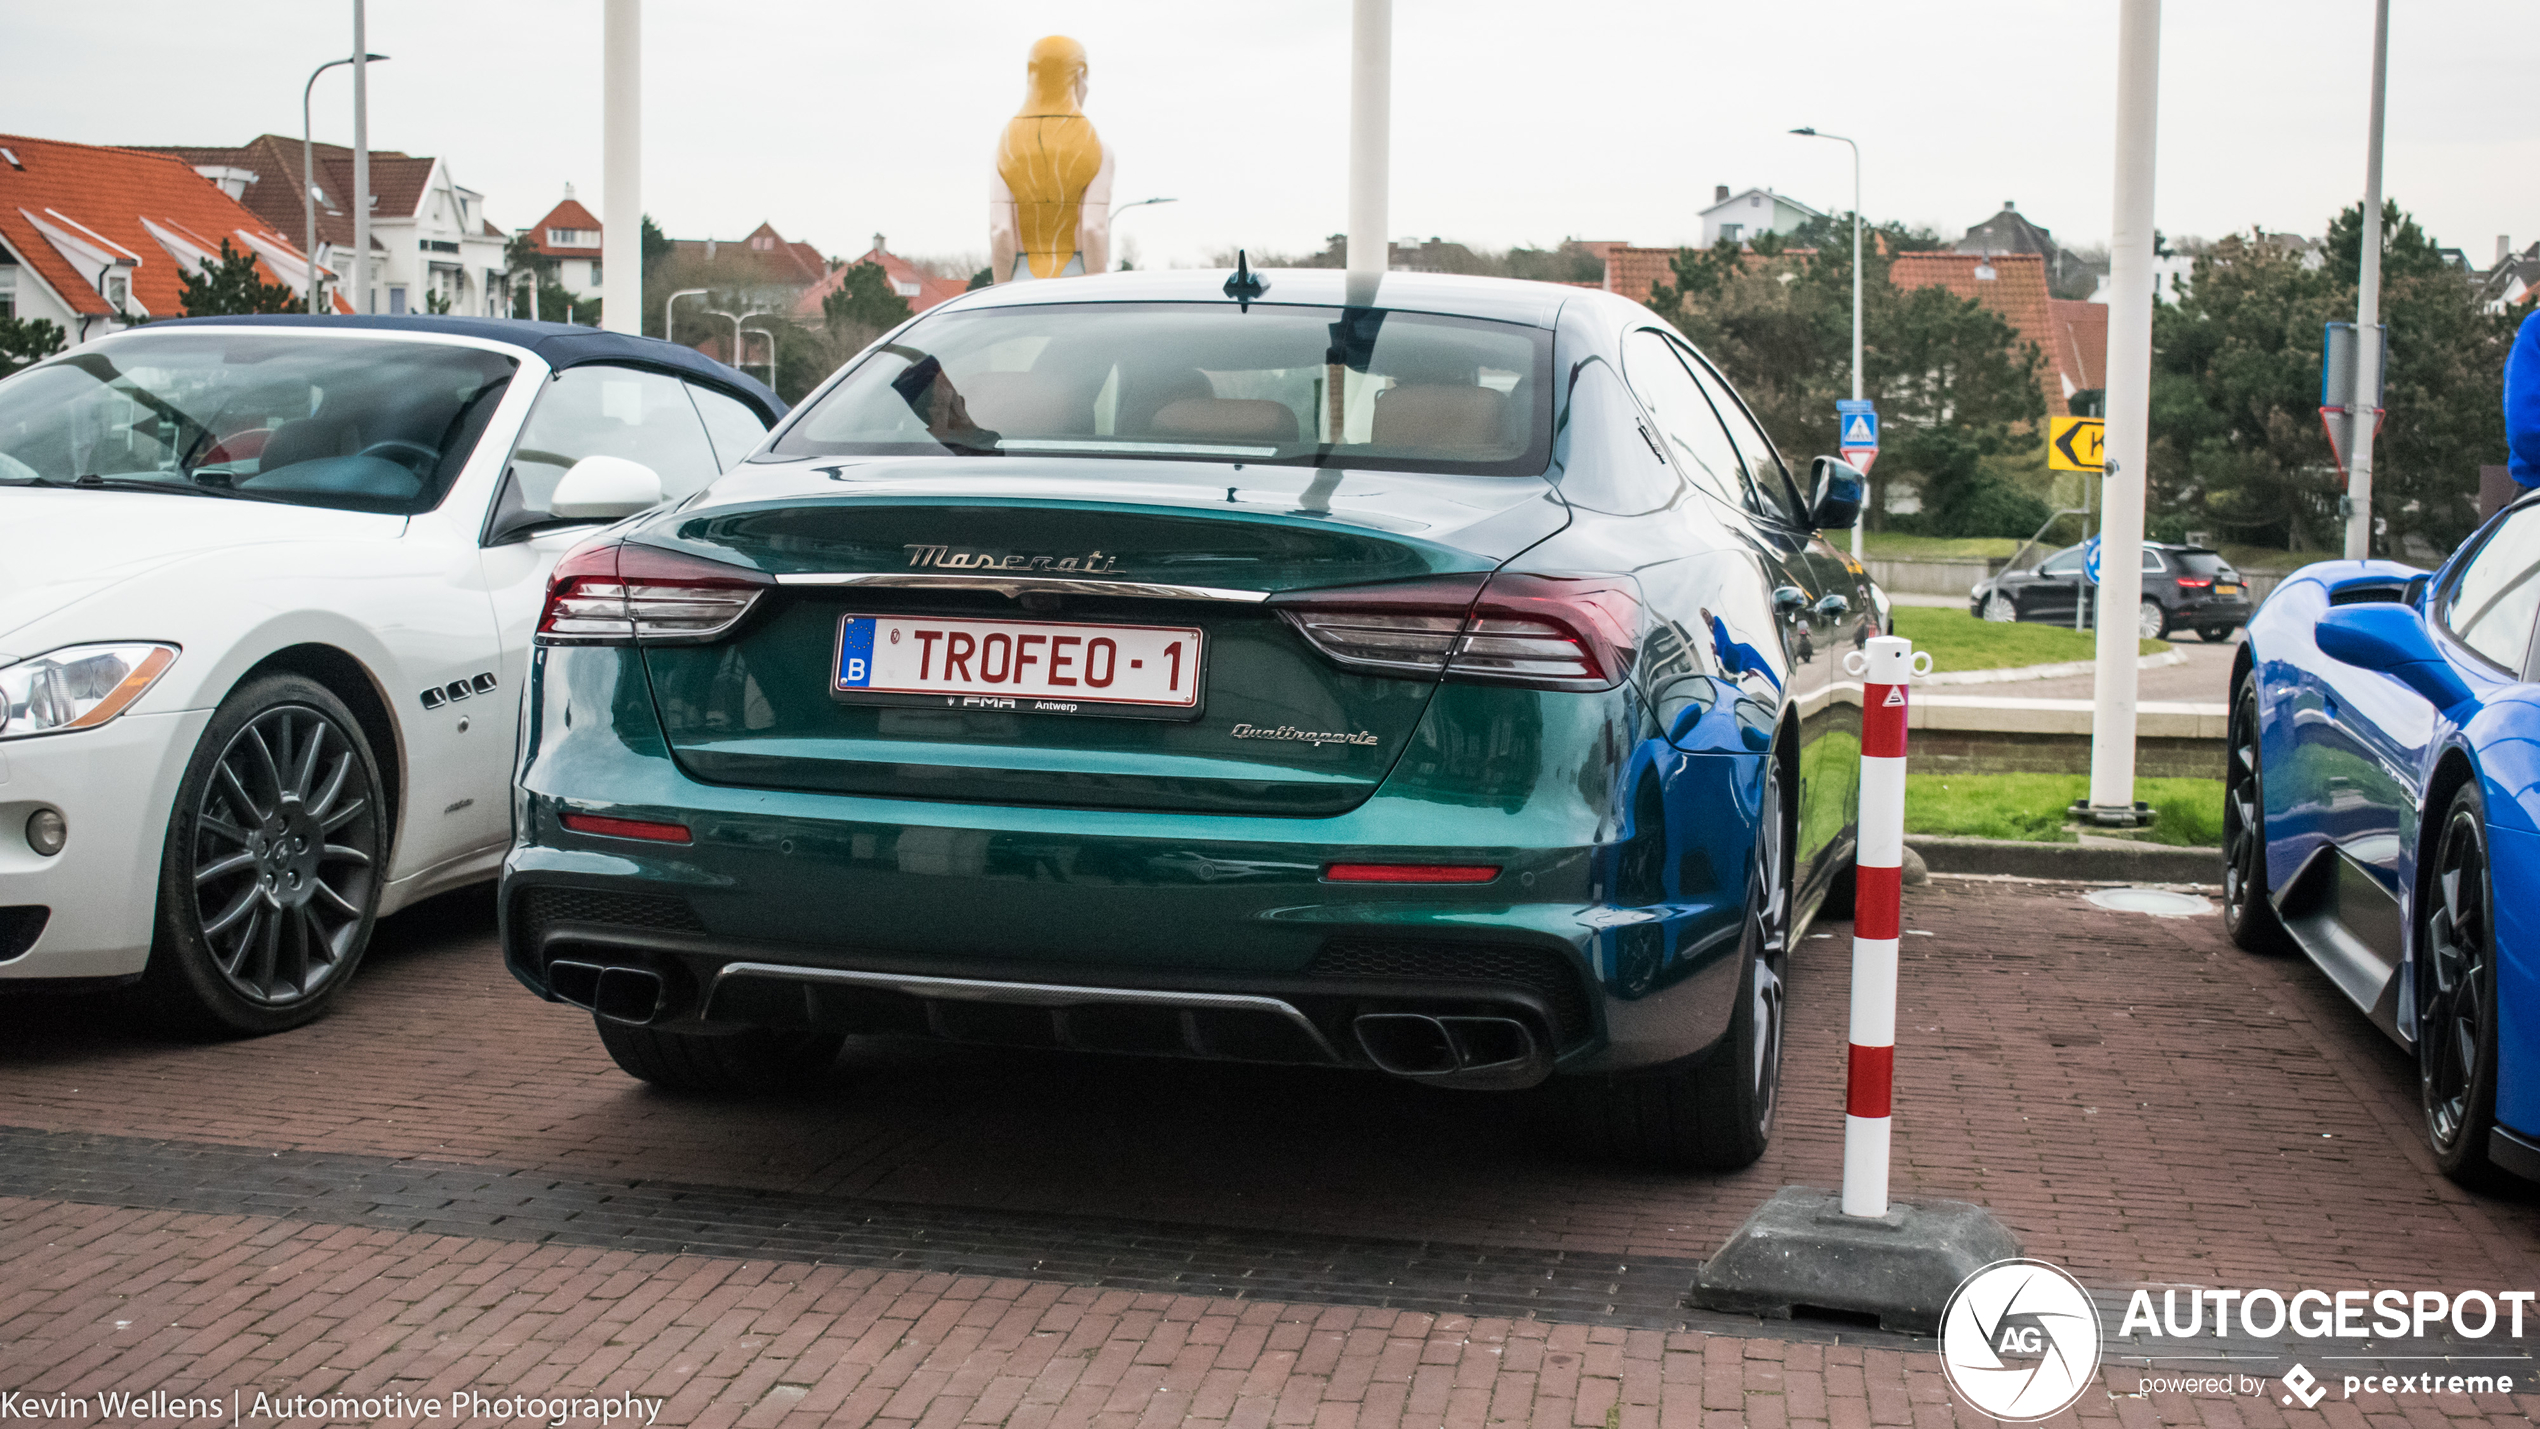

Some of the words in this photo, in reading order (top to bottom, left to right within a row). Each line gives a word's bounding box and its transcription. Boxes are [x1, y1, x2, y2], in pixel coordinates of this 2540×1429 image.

[903, 544, 1127, 575] Maserati
[847, 658, 866, 681] B
[963, 697, 1016, 709] FMA
[1034, 700, 1078, 713] Antwerp
[1230, 723, 1378, 747] Quattroporte
